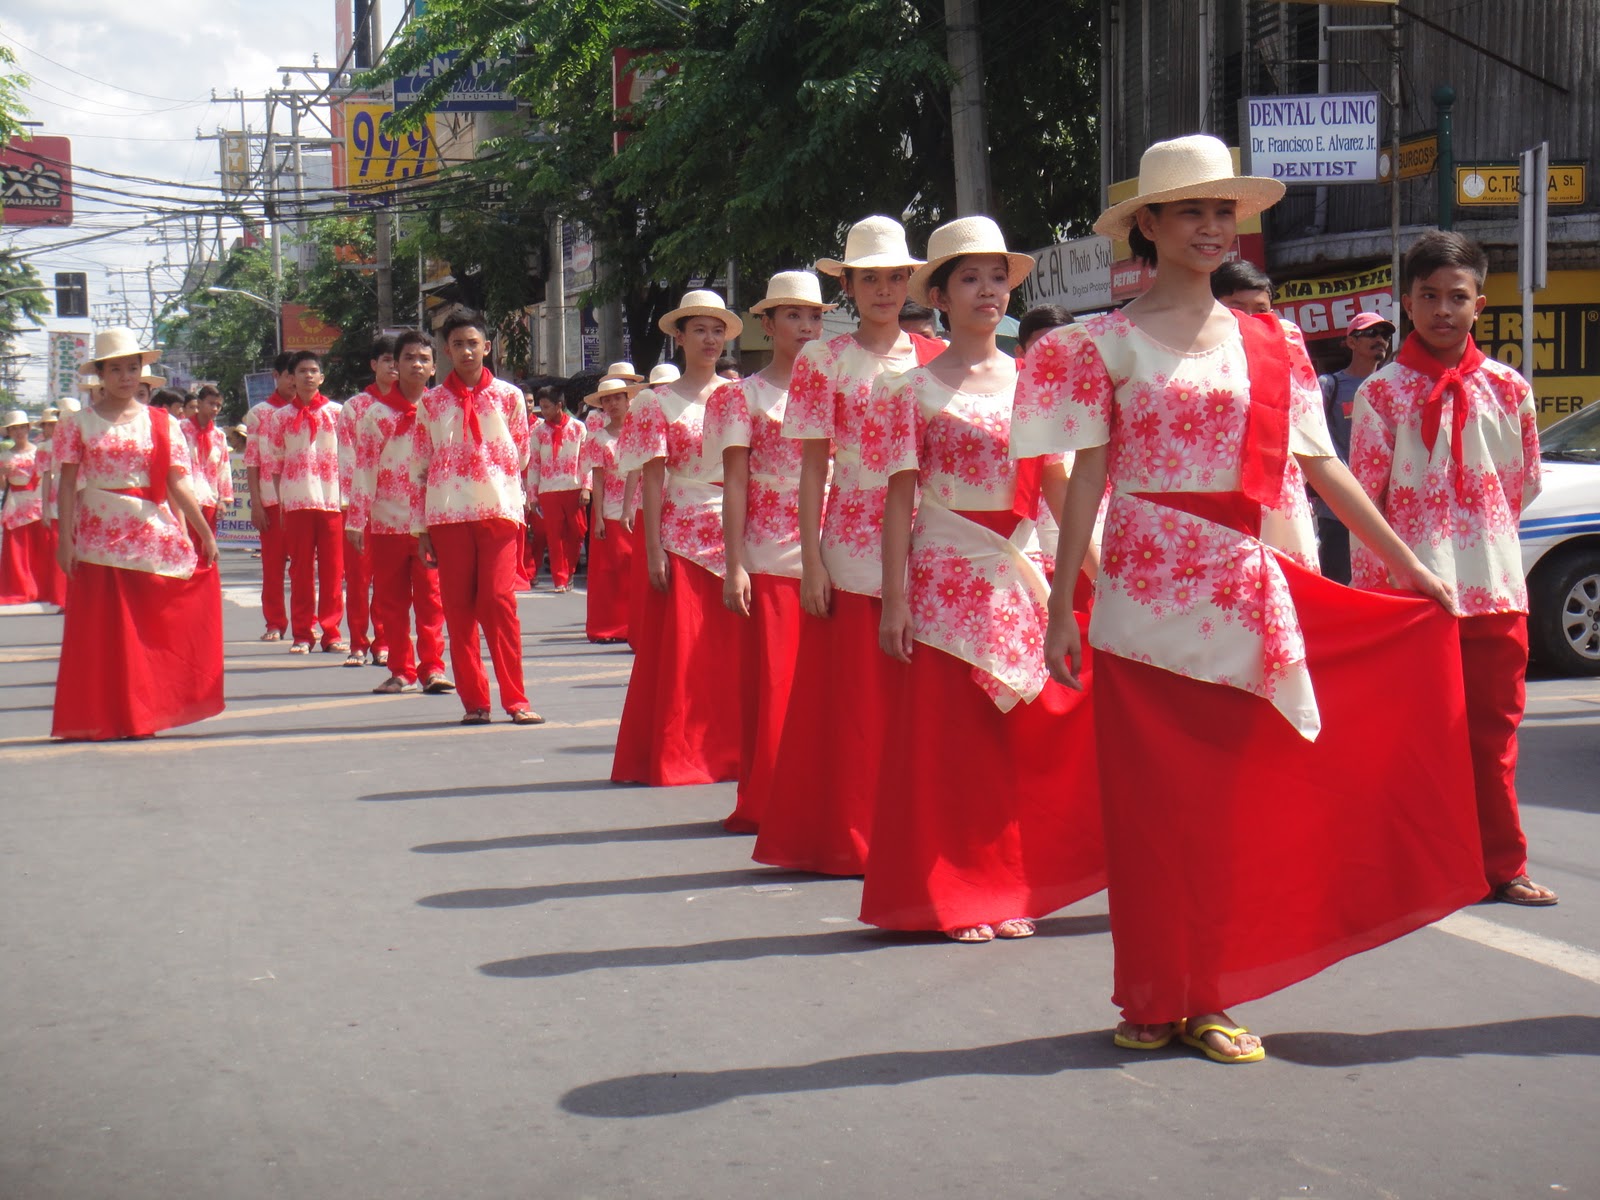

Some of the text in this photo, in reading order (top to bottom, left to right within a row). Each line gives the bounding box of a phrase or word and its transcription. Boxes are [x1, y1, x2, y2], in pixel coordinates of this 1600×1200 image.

[1250, 99, 1376, 127] DENTAL CLINIC
[1252, 134, 1377, 153] Dr. Francisco E. Alvarez Jr.
[1272, 161, 1357, 177] DENTIST
[1563, 174, 1576, 187] St.
[1069, 248, 1091, 276] Photo
[1094, 239, 1112, 270] Stud
[1275, 292, 1392, 333] NGER
[1475, 312, 1555, 341] ERN
[1481, 343, 1555, 370] ION
[1534, 396, 1584, 413] SFER
